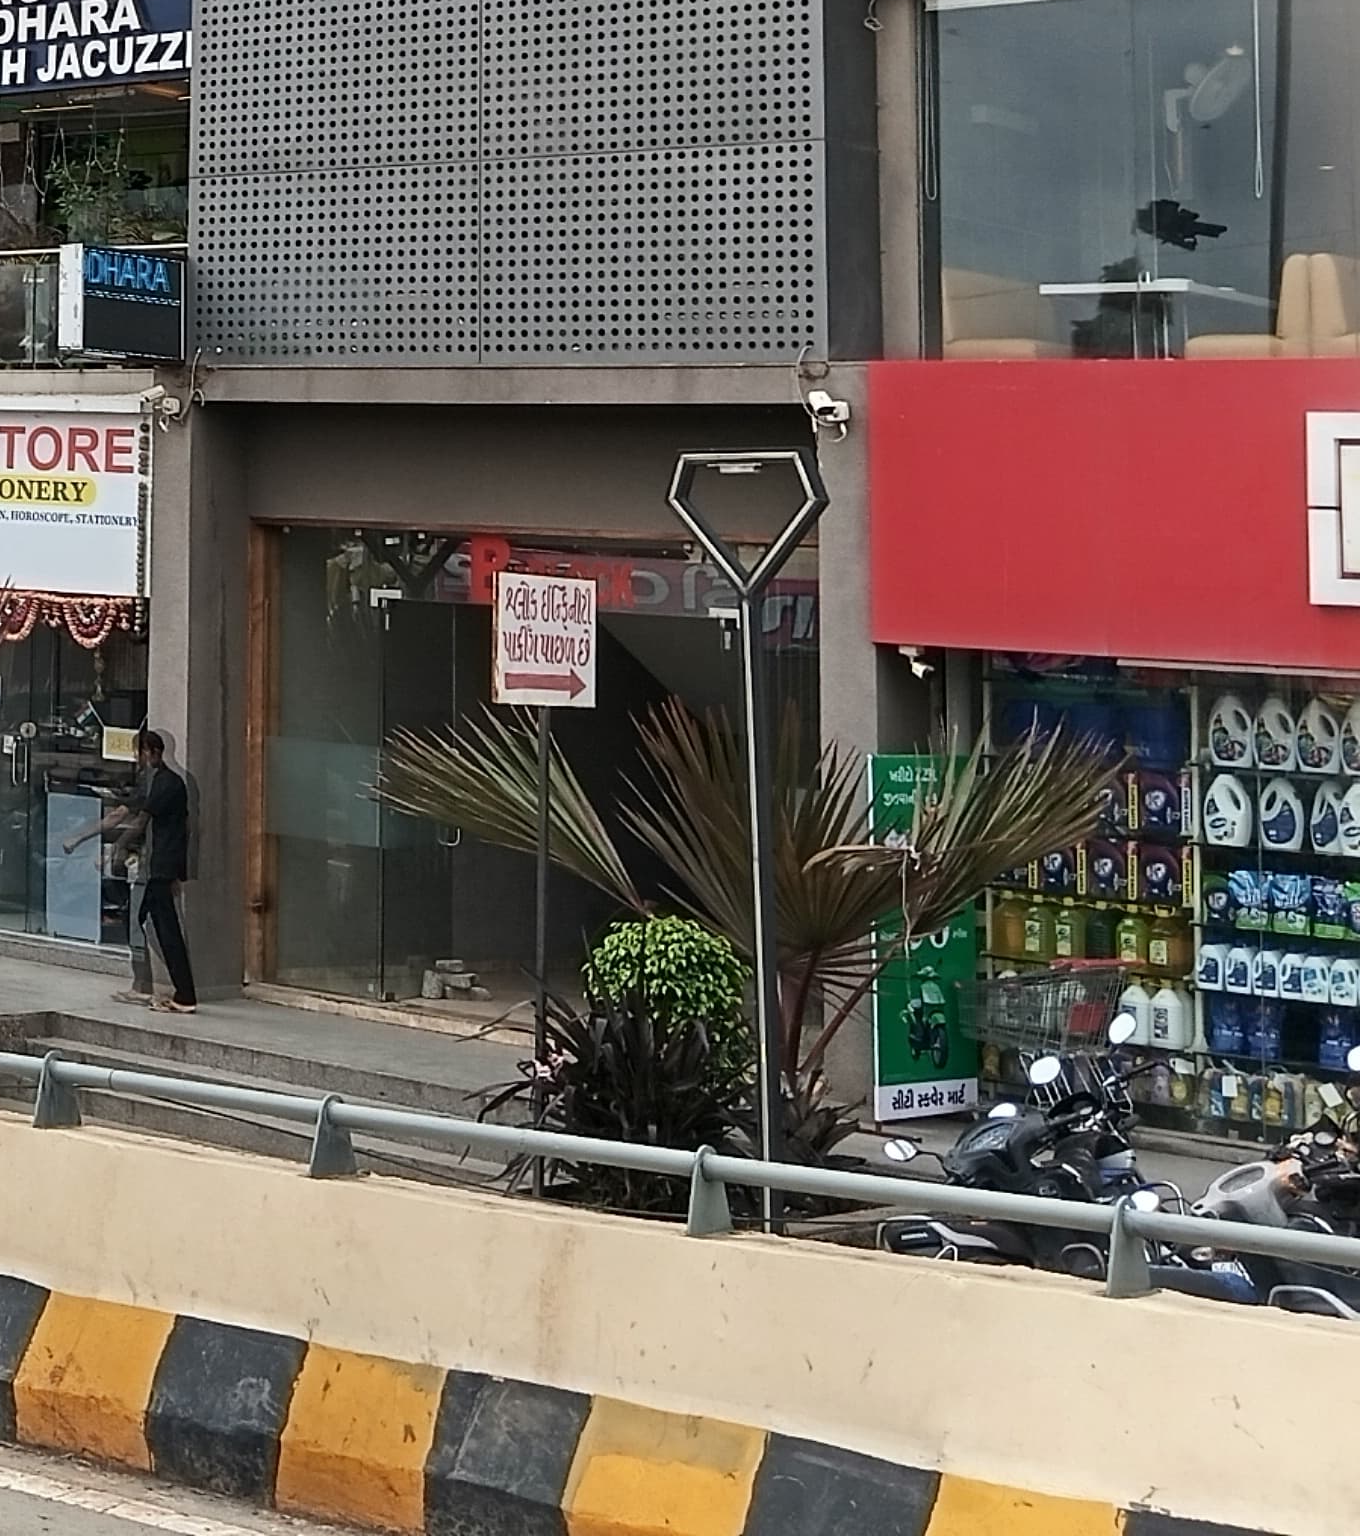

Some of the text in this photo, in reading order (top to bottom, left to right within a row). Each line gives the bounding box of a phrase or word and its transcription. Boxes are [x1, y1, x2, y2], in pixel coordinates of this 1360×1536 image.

[36, 31, 193, 84] JACUZZI
[890, 1081, 967, 1112] સીટી માર્ટ
